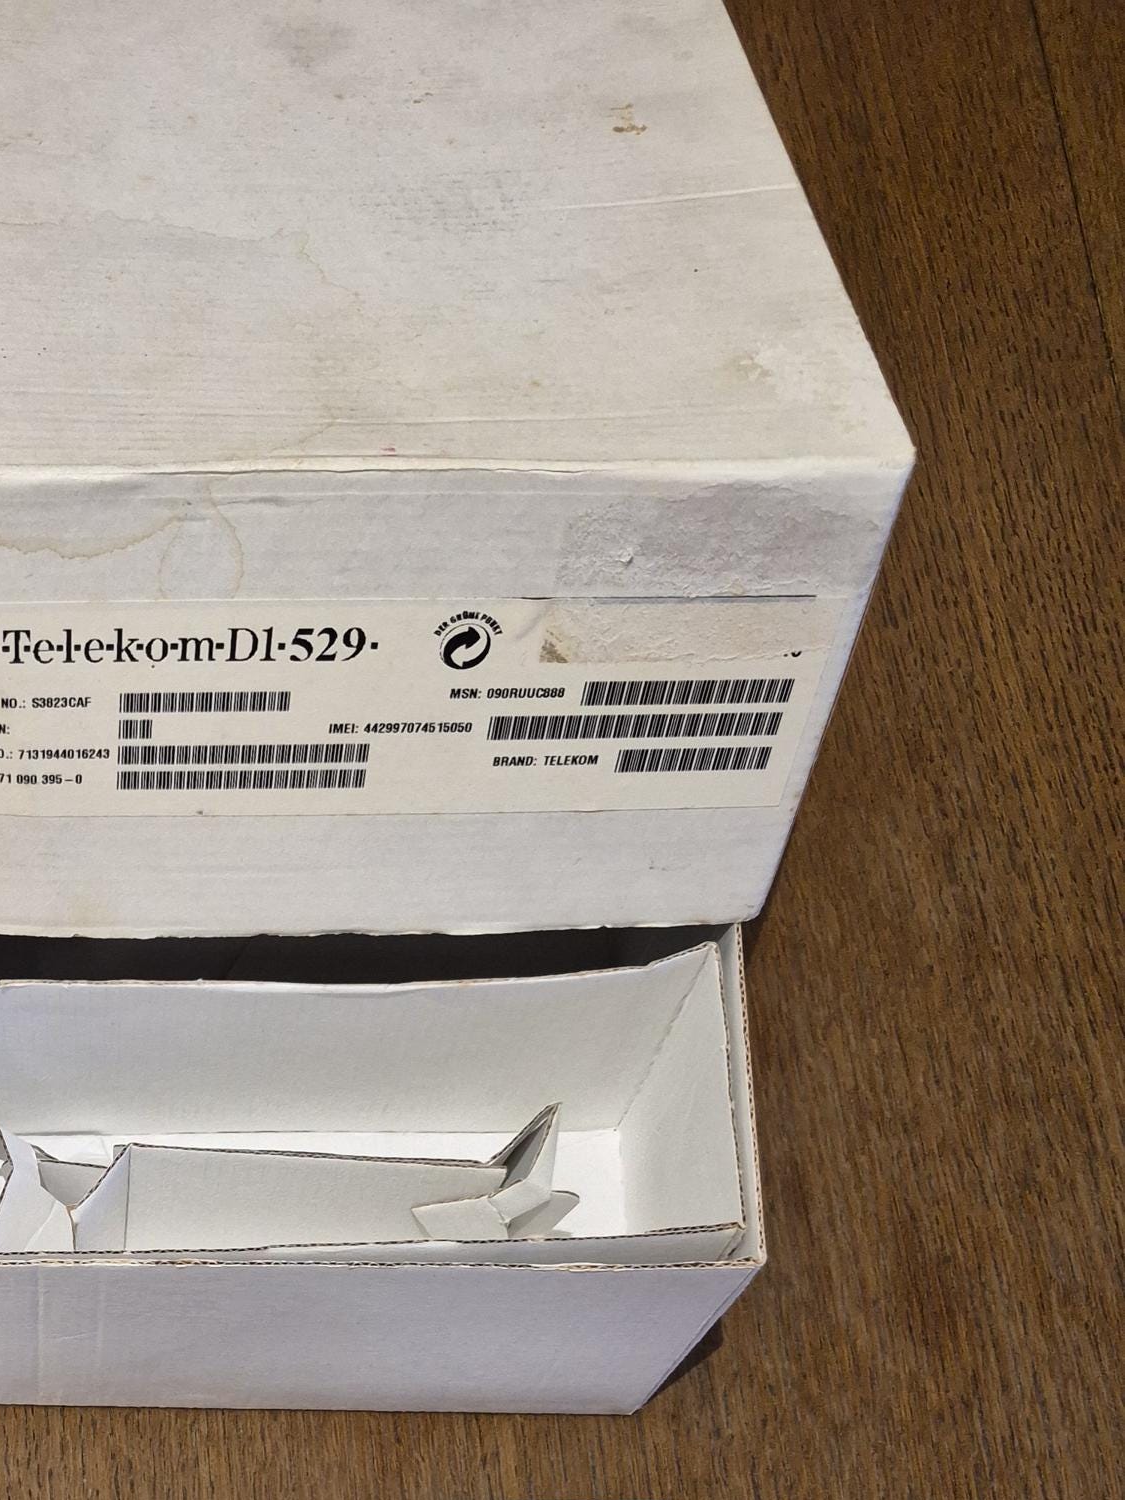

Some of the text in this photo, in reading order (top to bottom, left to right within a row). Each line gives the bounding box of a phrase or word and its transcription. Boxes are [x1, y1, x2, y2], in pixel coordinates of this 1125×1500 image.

[450, 688, 565, 699] MSN: 090RUUC888
[32, 697, 91, 709] S3823CAF
[329, 722, 472, 734] IMEI: 442997074515050
[18, 749, 110, 760] 7131944016243
[493, 755, 599, 766] BRAND: TELEKOM
[16, 775, 37, 784] 090
